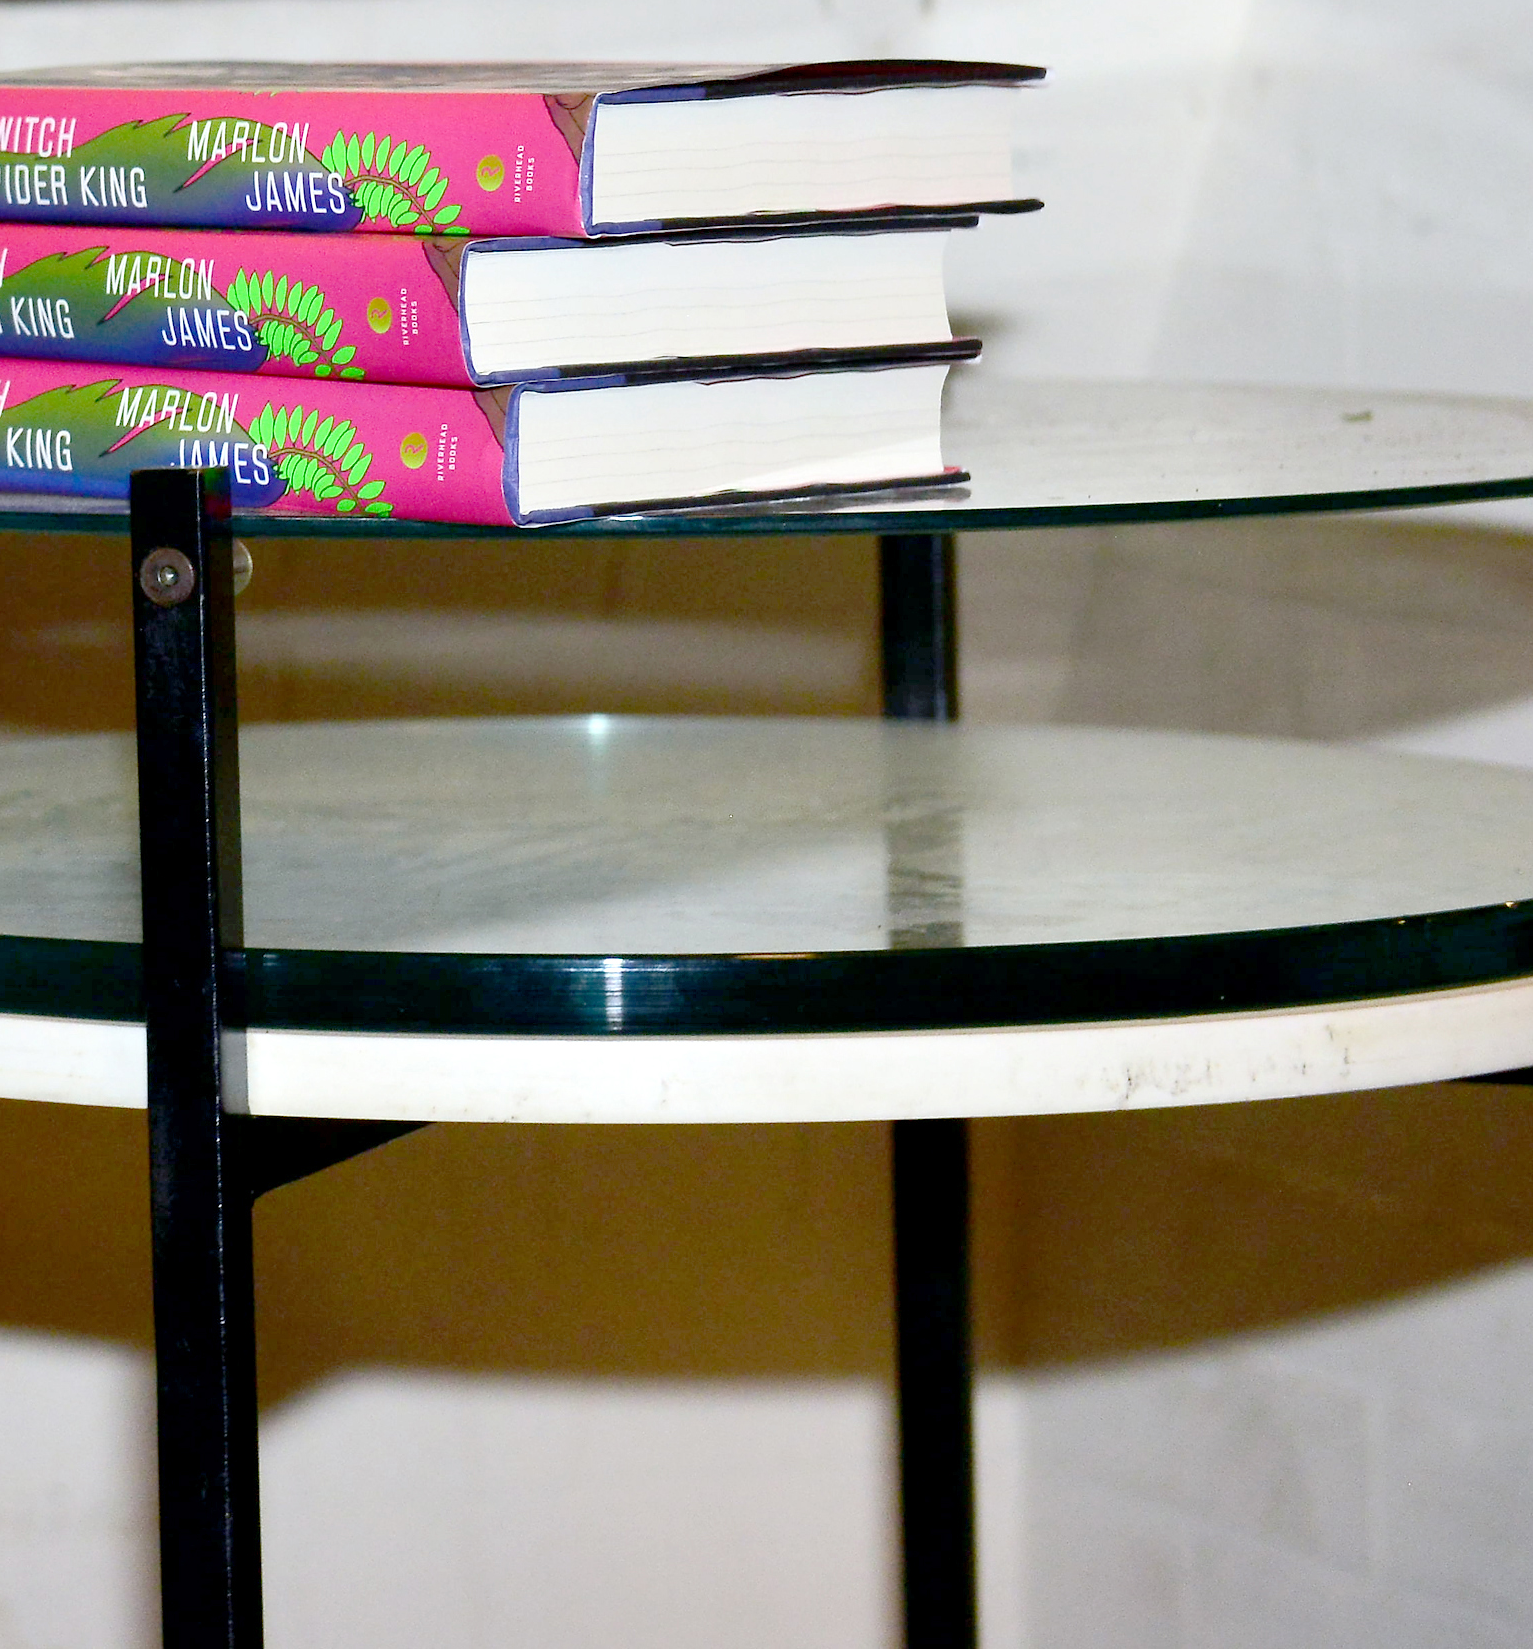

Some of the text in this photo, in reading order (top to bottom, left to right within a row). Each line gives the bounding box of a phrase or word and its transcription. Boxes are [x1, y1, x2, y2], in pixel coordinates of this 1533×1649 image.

[187, 120, 309, 164] MARLON
[81, 165, 147, 208] KING
[246, 170, 345, 214] JAMES
[514, 145, 524, 203] RIVERHEAD
[526, 157, 535, 191] BOOKS
[105, 254, 215, 300] MARLON
[11, 296, 74, 339] KING
[162, 306, 252, 352] JAMES
[400, 288, 409, 346] RIVERHEAD
[411, 301, 419, 335] BOOKS
[115, 387, 239, 434] MARLON
[6, 427, 73, 471] KING
[437, 423, 448, 481] RIVERHEAD
[449, 435, 458, 471] BOOKS
